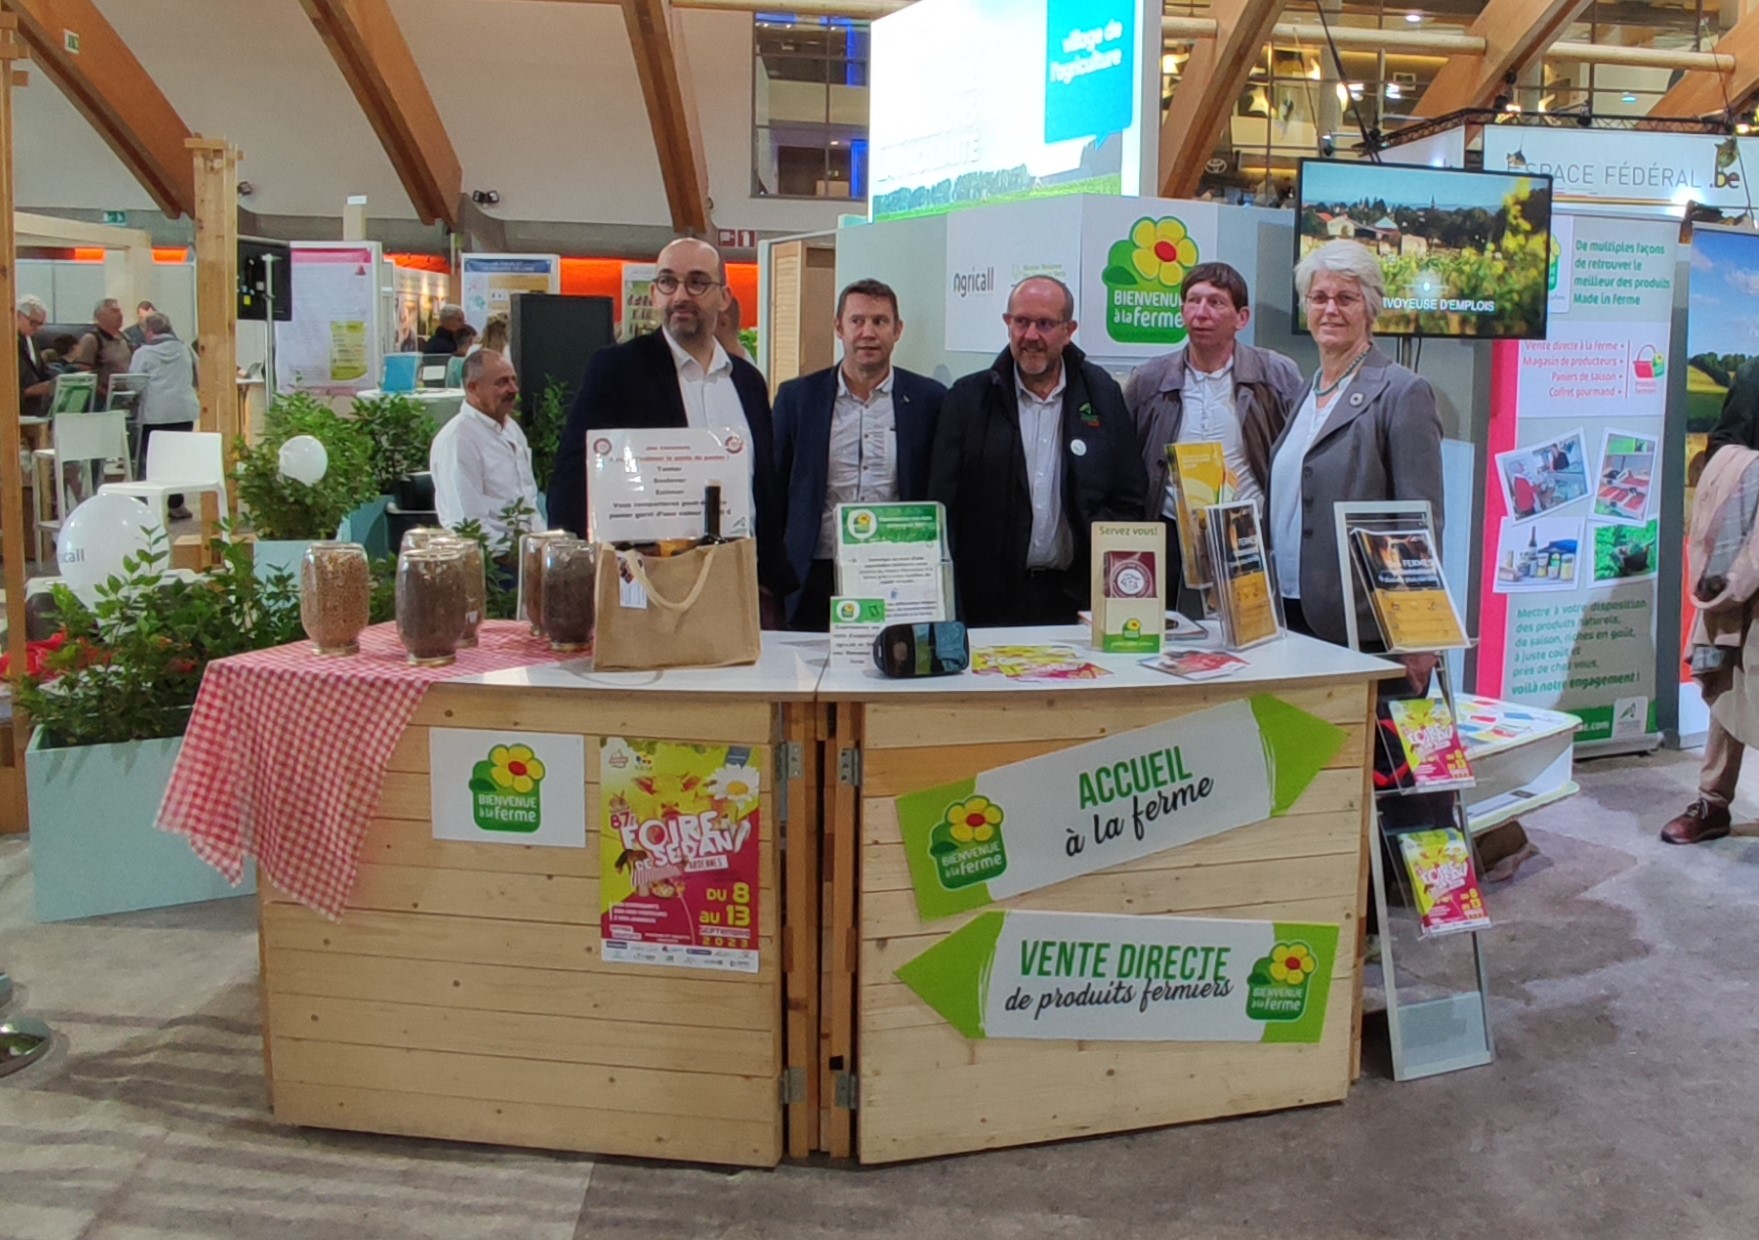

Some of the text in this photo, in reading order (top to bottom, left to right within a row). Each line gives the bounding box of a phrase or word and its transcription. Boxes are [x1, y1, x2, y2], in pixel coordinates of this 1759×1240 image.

[1605, 161, 1702, 188] FÉDÉRAL
[1576, 240, 1665, 256] De multiples façons
[1575, 259, 1642, 271] de retrouver le
[1574, 276, 1670, 289] meilleur des produits
[1440, 299, 1496, 312] D'EMPLOIS
[1574, 293, 1598, 304] Made
[1601, 293, 1610, 304] in
[1613, 294, 1641, 305] ferme
[1114, 306, 1184, 328] à la ferme
[1525, 341, 1551, 350] Vente
[1594, 340, 1618, 350] ferme
[1523, 357, 1617, 367] Magasin de producteurs
[1551, 372, 1616, 382] Paniers de saison
[1576, 387, 1616, 398] gourmand
[1099, 526, 1158, 536] Servez vous!
[1517, 606, 1550, 618] Mettre
[1562, 603, 1587, 614] votre
[1590, 600, 1647, 613] disposition
[1516, 622, 1533, 633] des
[1536, 618, 1576, 632] produits
[1515, 637, 1528, 648] de
[1596, 630, 1609, 639] en
[1514, 649, 1520, 662] à
[1521, 650, 1546, 664] juste
[1513, 664, 1534, 678] près
[1536, 662, 1548, 673] de
[1551, 661, 1572, 673] chez
[1512, 680, 1538, 695] voilà
[1540, 678, 1566, 692] notre
[1569, 673, 1635, 690] engagement
[1079, 745, 1193, 810] ACCUEIL
[478, 794, 537, 808] BIENVENUE
[495, 806, 537, 822] ferme
[1065, 777, 1214, 857] à la ferme
[621, 811, 718, 851] FOIRE
[941, 841, 1000, 867] BIENVENUE
[961, 854, 1002, 875] ferme
[706, 882, 750, 904] DU 8
[699, 905, 750, 926] au 13
[1020, 939, 1231, 981] VENTE DIRECTE
[1004, 976, 1234, 1021] de produits fermiers
[1252, 987, 1303, 999] BIENVENUE
[1265, 998, 1301, 1011] ferme
